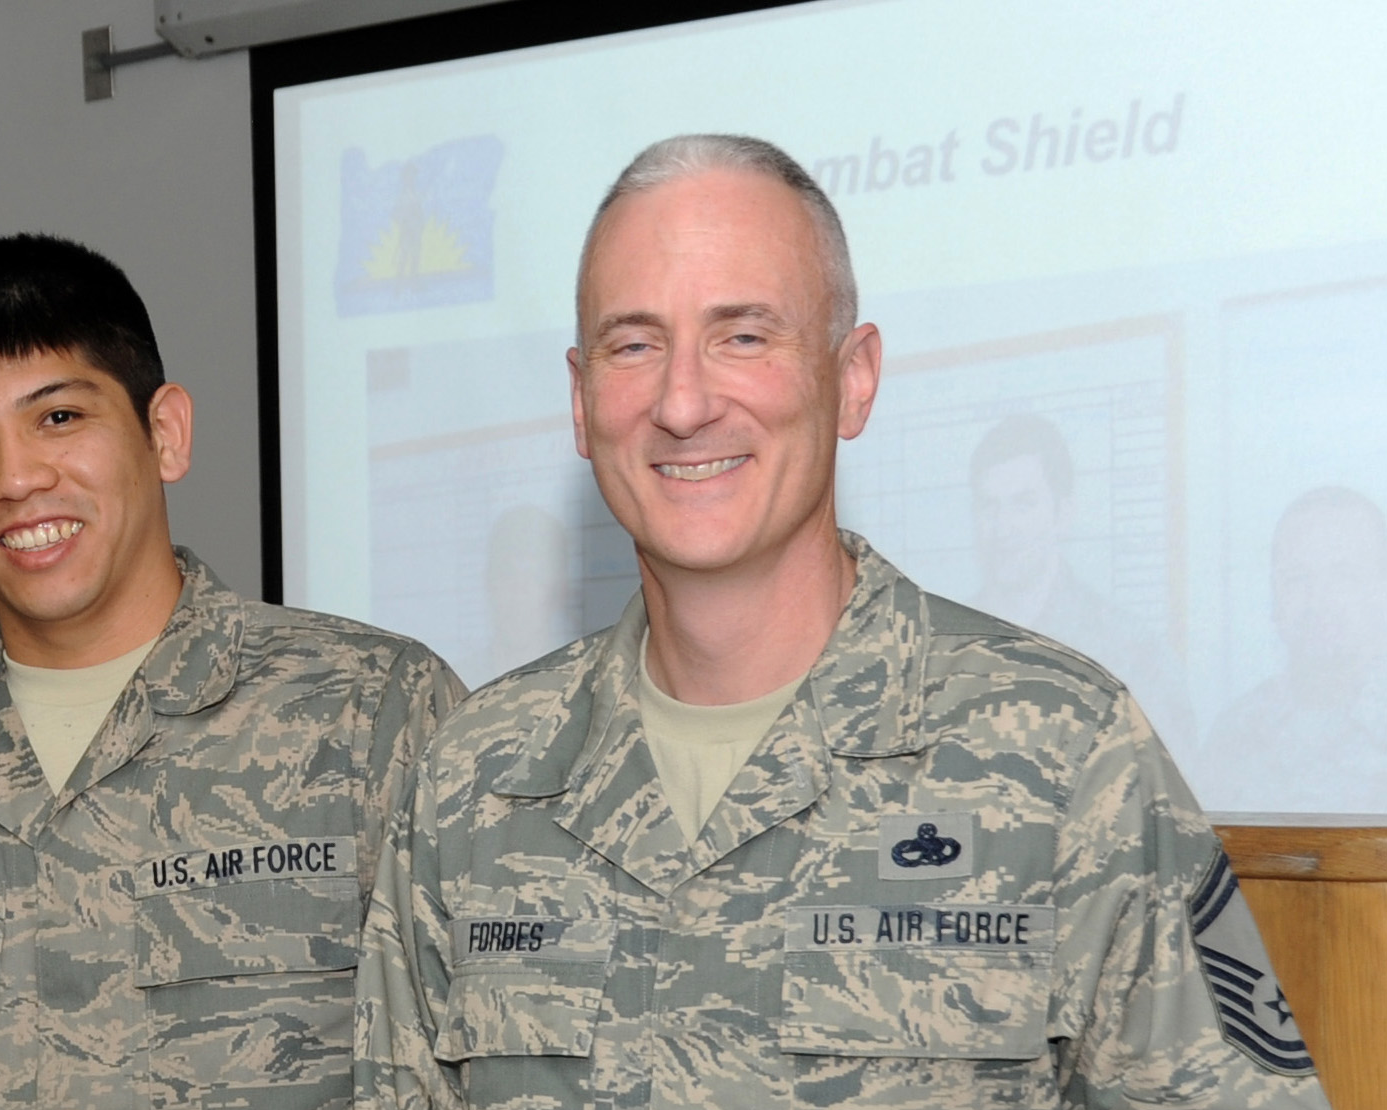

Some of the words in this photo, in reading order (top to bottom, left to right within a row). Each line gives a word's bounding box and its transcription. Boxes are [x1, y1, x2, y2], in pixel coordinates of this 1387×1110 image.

[814, 128, 961, 197] mbat
[980, 92, 1186, 177] Shield
[152, 856, 195, 888] U.S.
[205, 848, 243, 880] AIR
[253, 842, 337, 873] FORCE
[468, 921, 544, 953] FORBES
[813, 913, 862, 944] U.S.
[875, 910, 923, 943] AIR
[935, 910, 1030, 945] FORCE
